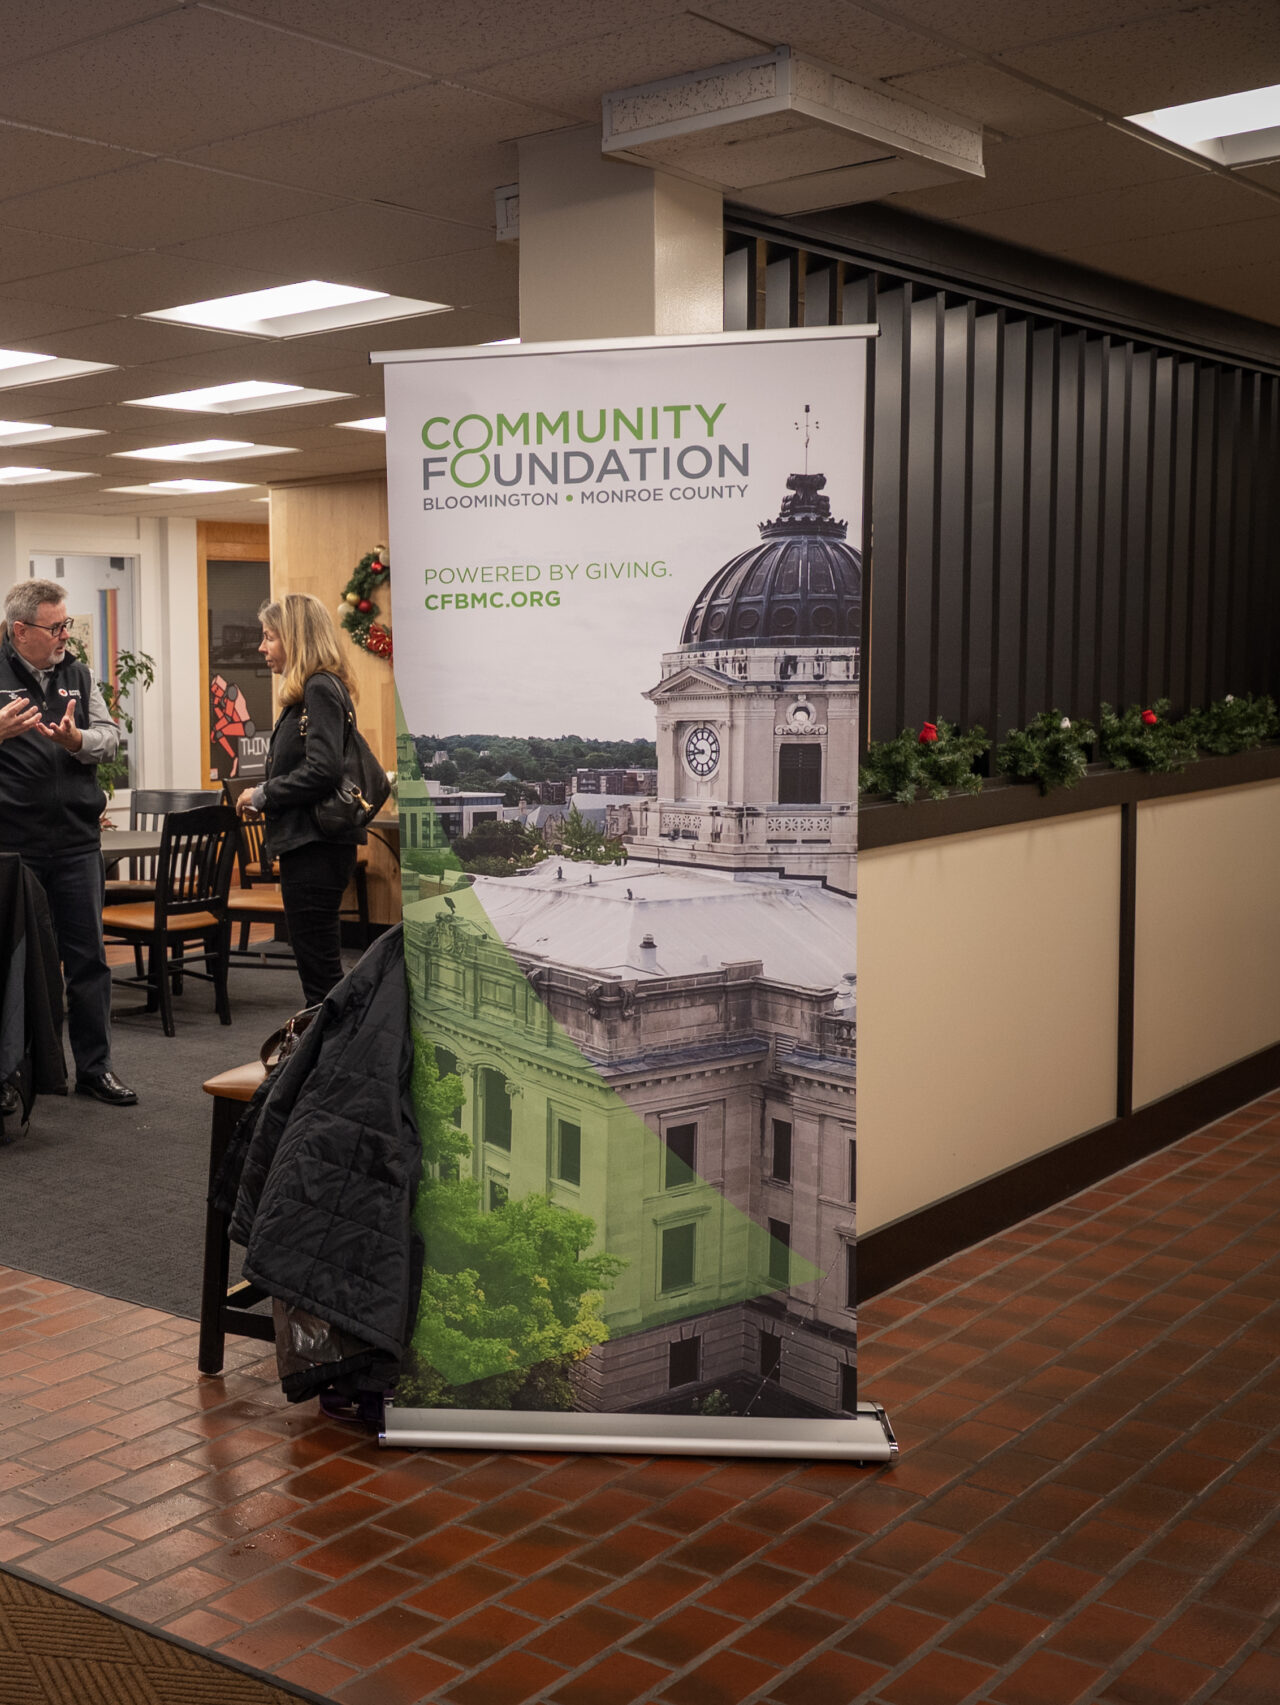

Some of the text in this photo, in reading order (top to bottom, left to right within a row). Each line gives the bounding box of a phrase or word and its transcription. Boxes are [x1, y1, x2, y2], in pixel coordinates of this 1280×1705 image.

[422, 403, 727, 450] COMMUNITY
[423, 443, 749, 490] FOUNDATION
[423, 484, 749, 510] BLOOMINGTON MONROE COUNTY
[425, 561, 673, 585] POWERED BY GIVING.
[424, 590, 561, 611] CFBMC.ORG
